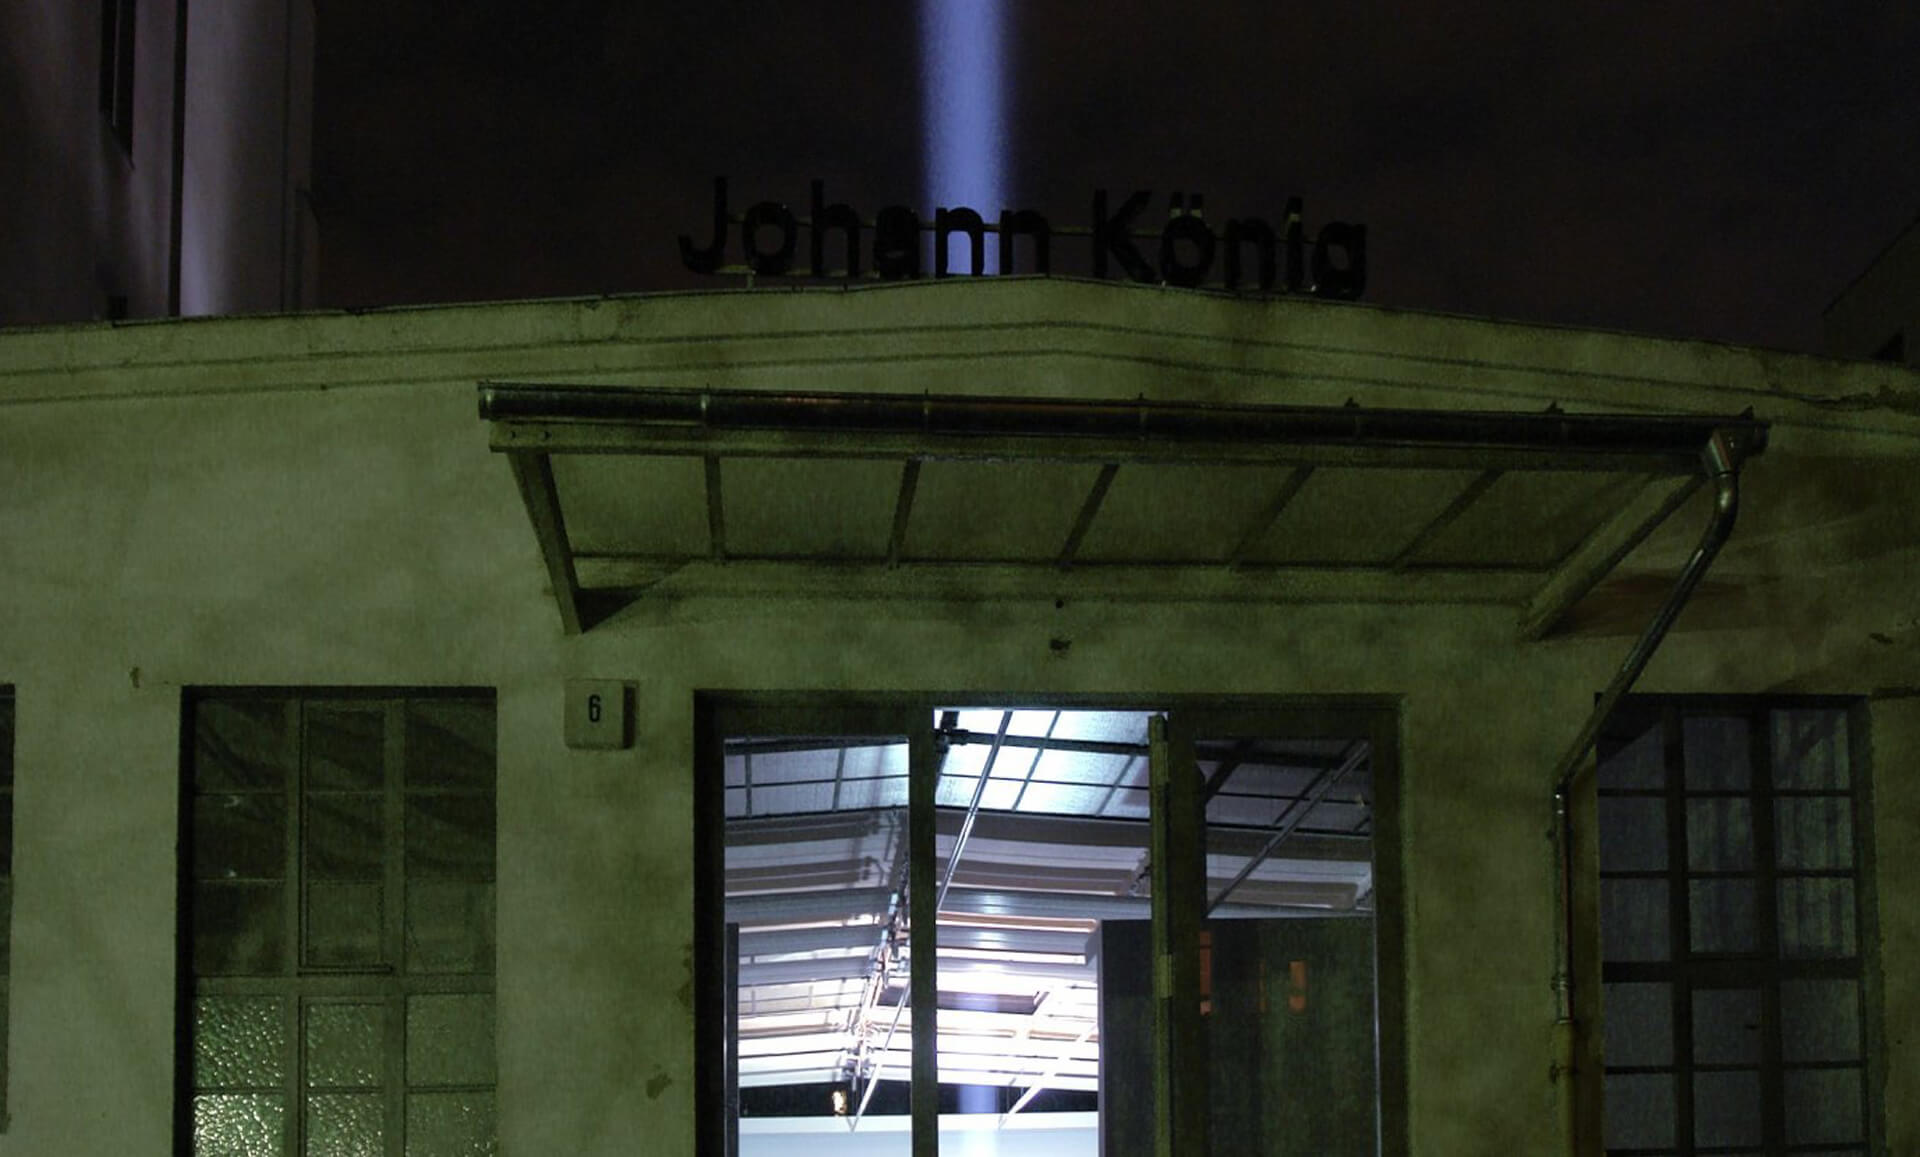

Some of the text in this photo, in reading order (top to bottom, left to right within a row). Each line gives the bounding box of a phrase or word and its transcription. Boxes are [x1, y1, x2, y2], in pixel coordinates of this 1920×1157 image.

[678, 176, 1366, 300] Johann König
[589, 694, 601, 722] 6
